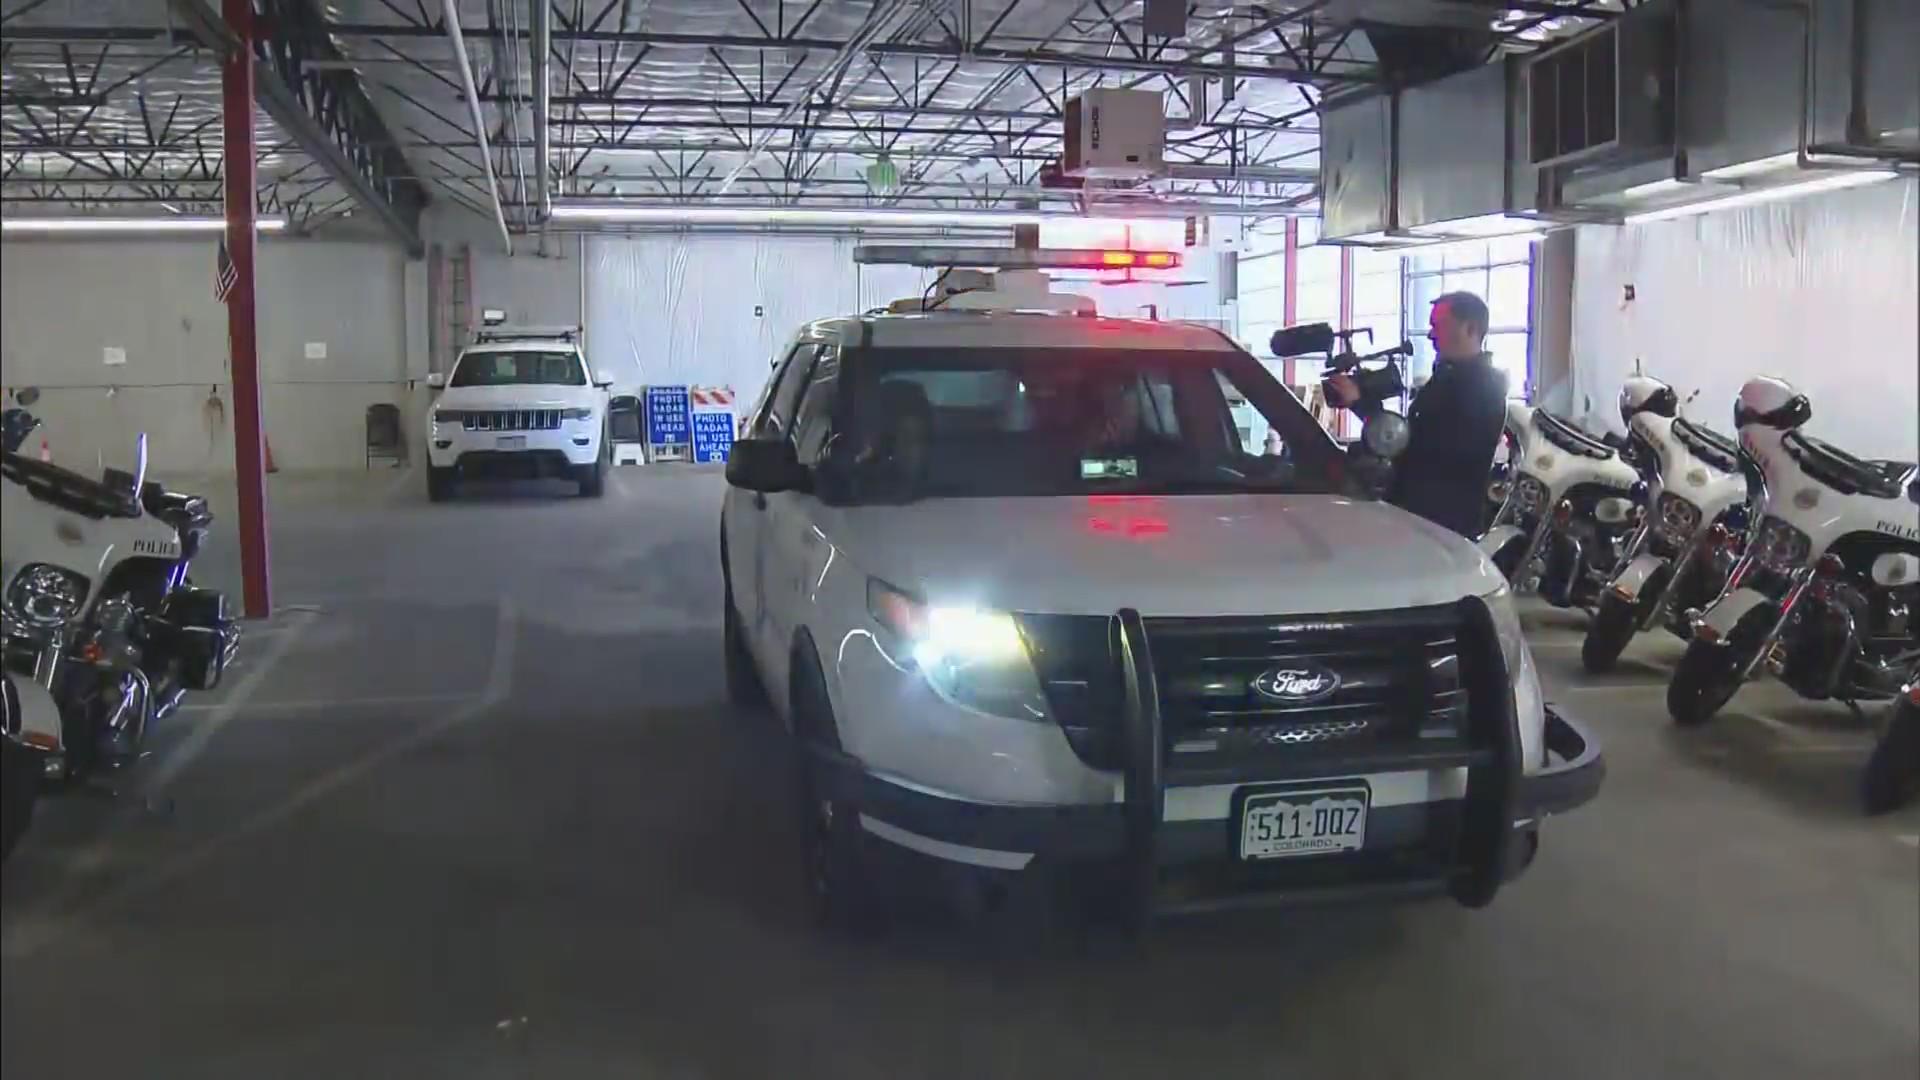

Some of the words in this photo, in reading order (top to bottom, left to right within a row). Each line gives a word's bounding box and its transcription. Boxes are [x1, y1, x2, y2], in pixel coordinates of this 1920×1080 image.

[653, 395, 684, 403] PHOTO
[653, 404, 684, 412] RADAR
[654, 414, 664, 422] IN
[666, 414, 684, 422] USE
[695, 414, 727, 423] PHOTO
[655, 423, 685, 432] AHEAD
[696, 423, 730, 432] RADAR
[697, 433, 708, 442] IN
[711, 433, 729, 442] USE
[699, 442, 730, 452] AHEAD
[1272, 669, 1329, 694] Ford
[1273, 838, 1333, 851] COLORADO
